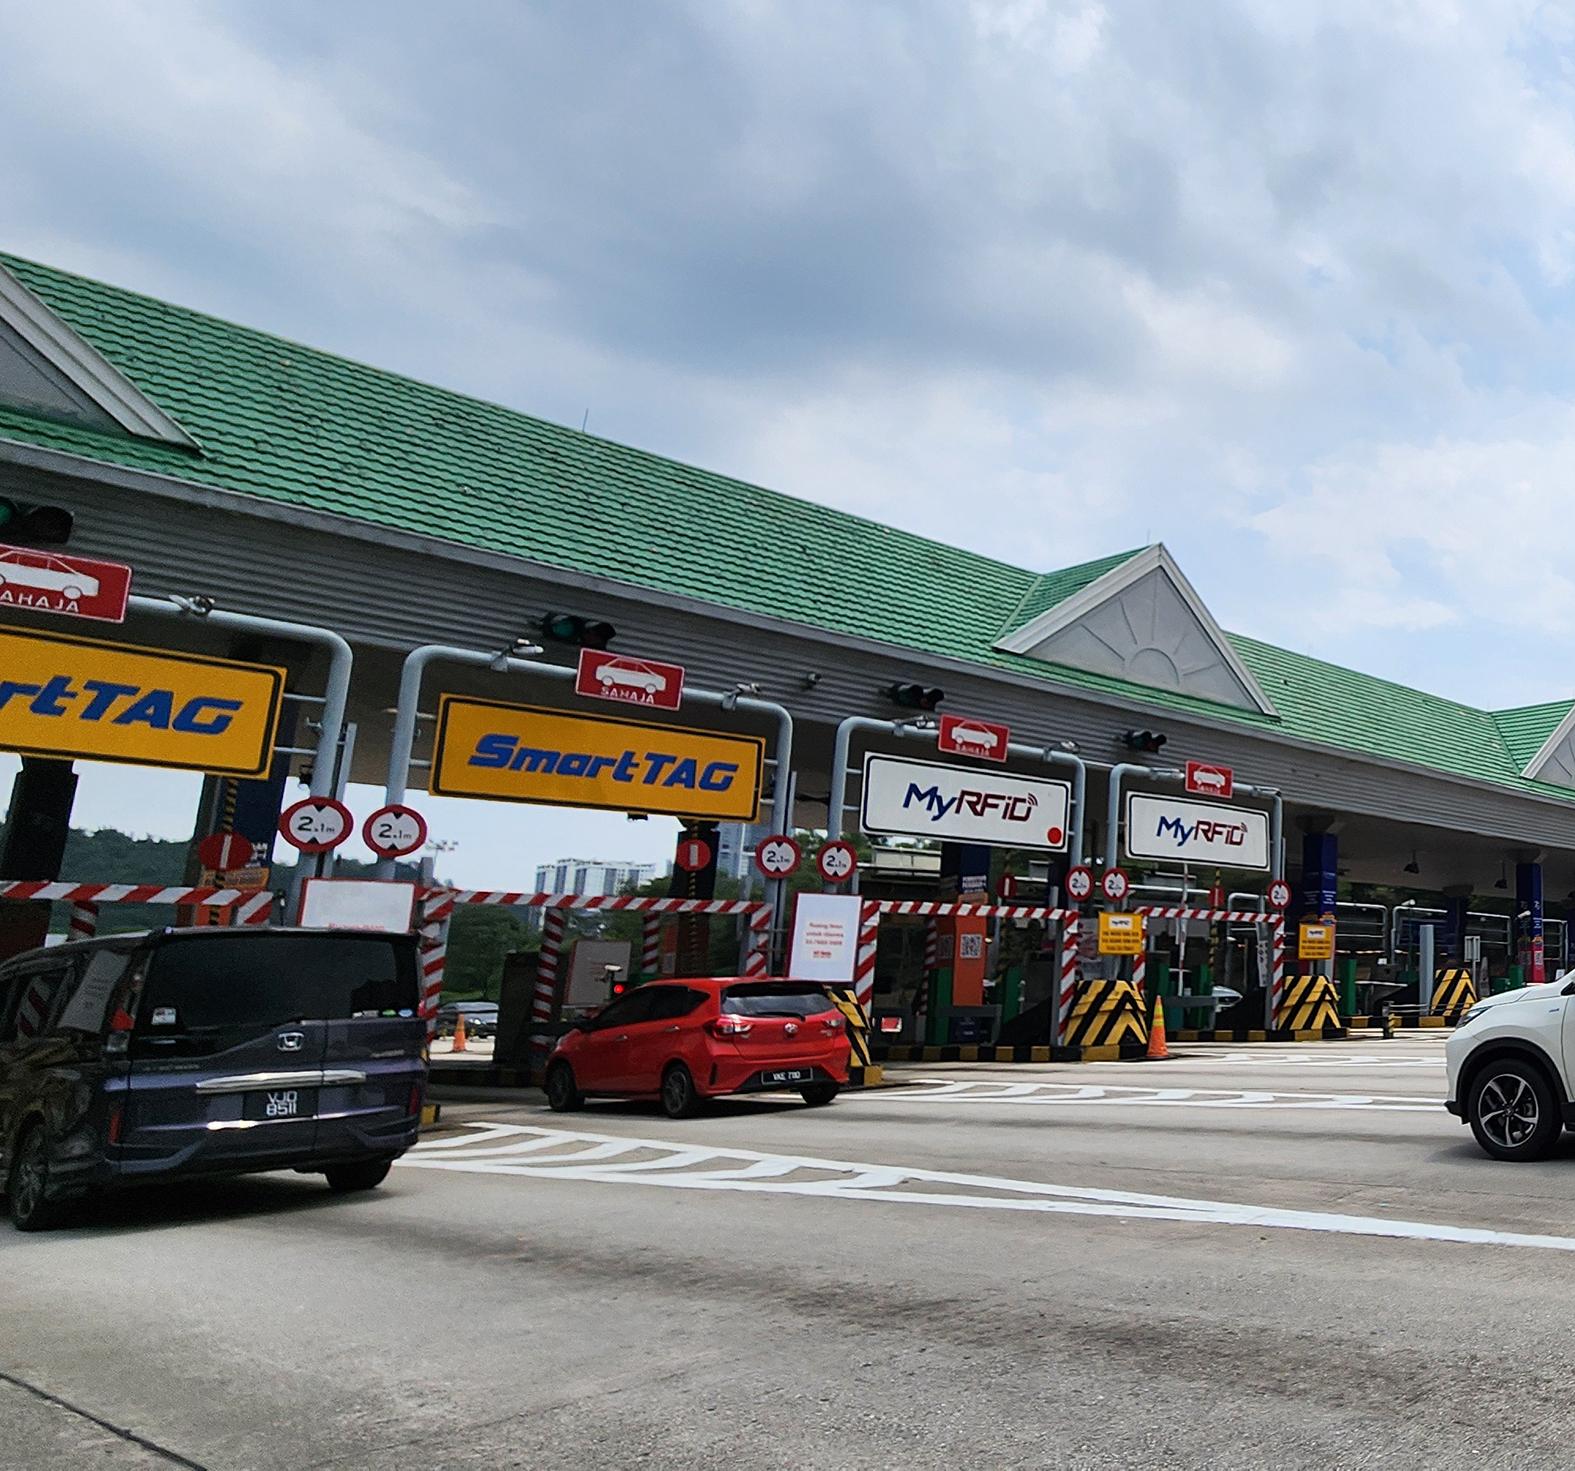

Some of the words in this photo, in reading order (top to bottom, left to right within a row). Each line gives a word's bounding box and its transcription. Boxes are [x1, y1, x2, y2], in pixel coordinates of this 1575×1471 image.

[0, 590, 79, 613] AHAJA
[0, 675, 244, 735] rtTAG
[600, 686, 655, 705] SAHAJA
[467, 733, 739, 792] SmartTAG
